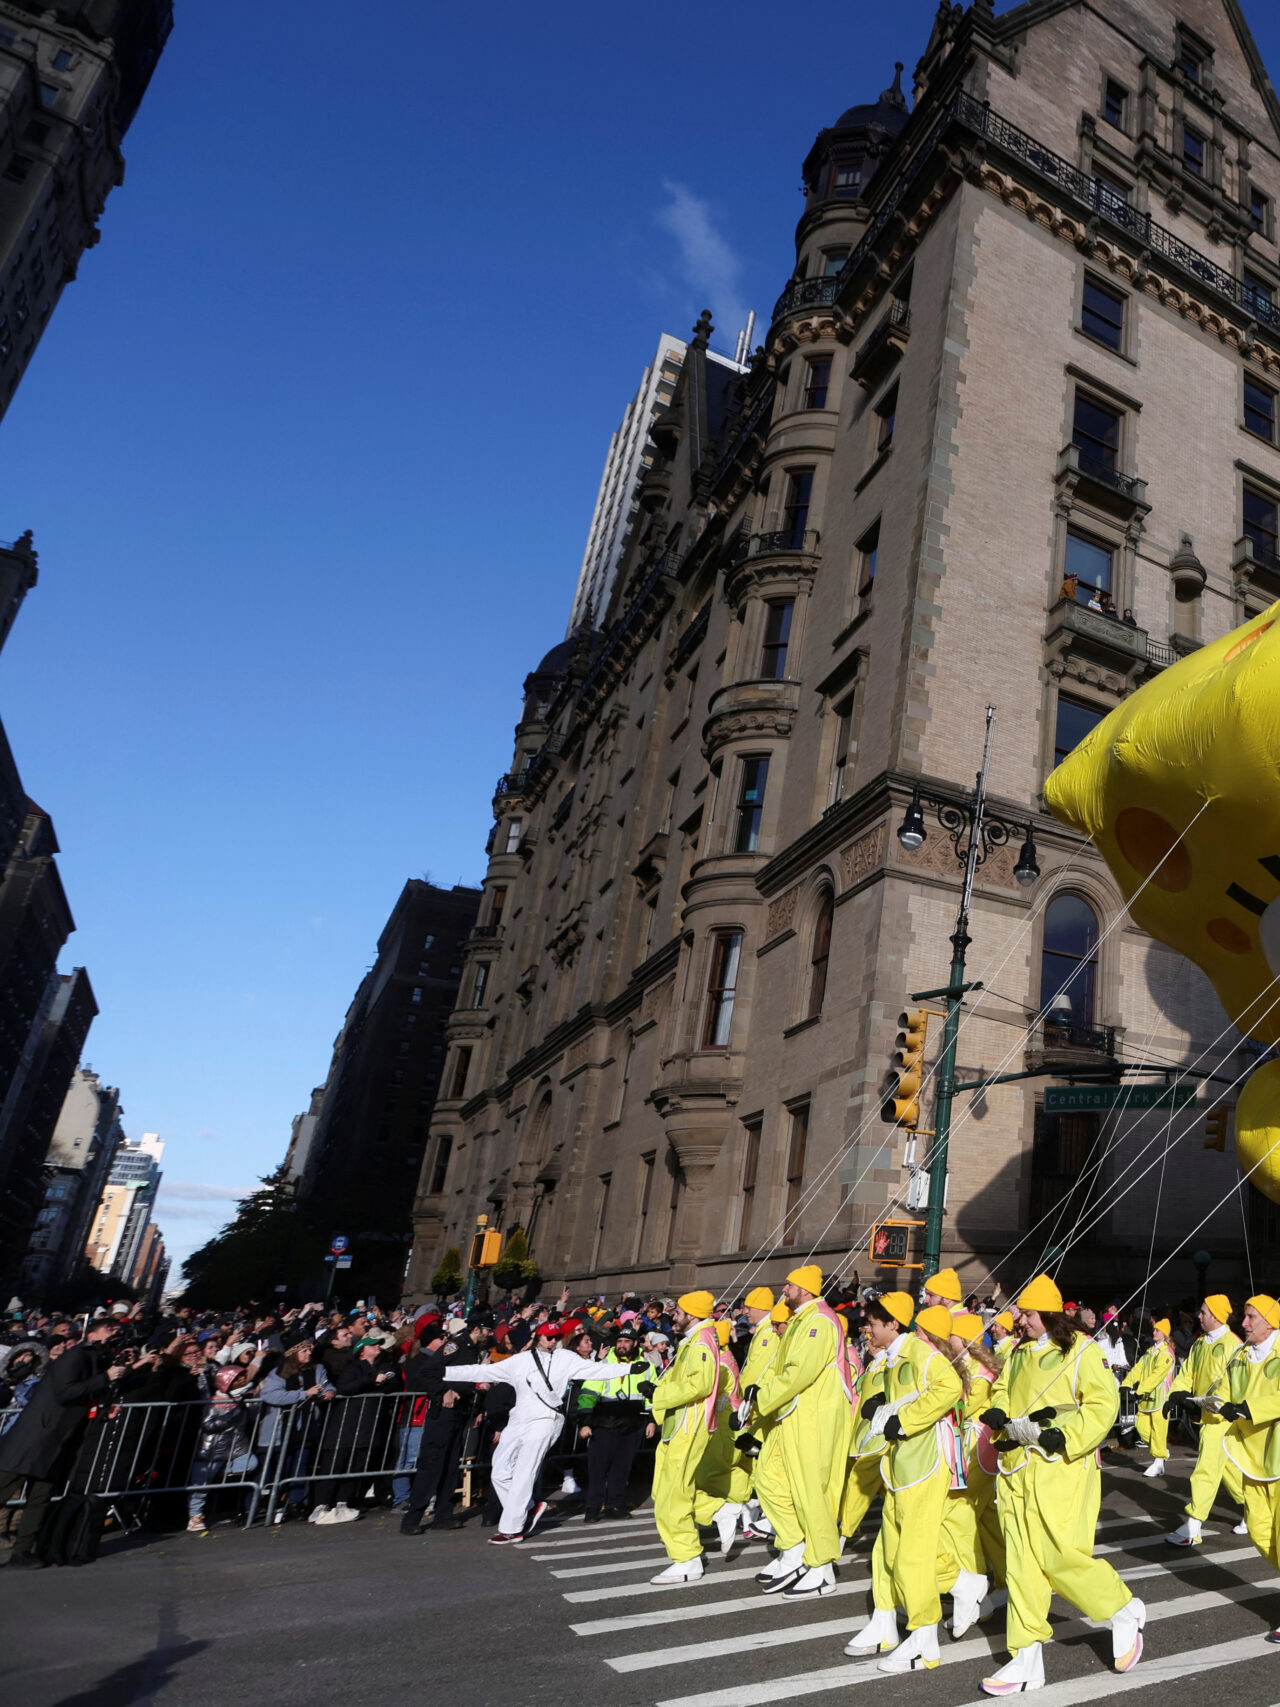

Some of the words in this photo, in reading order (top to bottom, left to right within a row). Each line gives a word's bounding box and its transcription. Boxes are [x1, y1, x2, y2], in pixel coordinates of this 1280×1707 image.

[1048, 1093, 1107, 1105] Central
[1113, 1091, 1150, 1104] Park
[1155, 1090, 1192, 1103] West
